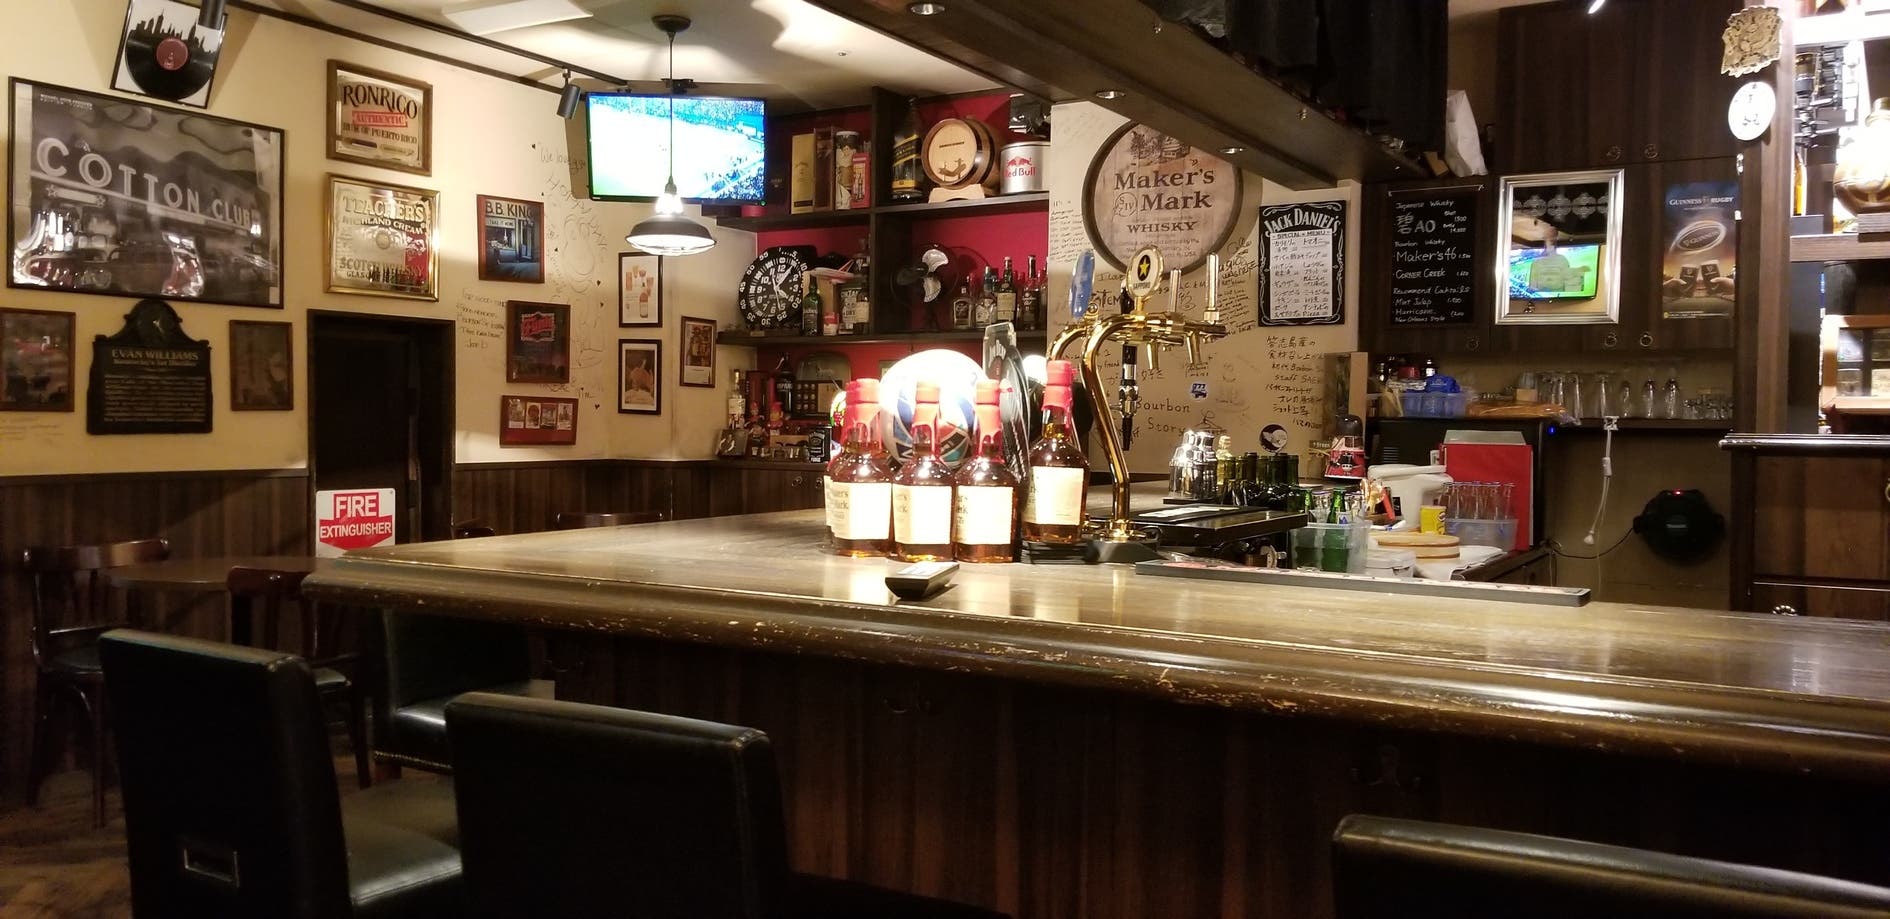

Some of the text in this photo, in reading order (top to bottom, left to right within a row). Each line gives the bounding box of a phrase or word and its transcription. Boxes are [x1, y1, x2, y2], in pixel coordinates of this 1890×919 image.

[343, 84, 418, 119] RONRICO
[1003, 166, 1036, 178] Red Bull
[1114, 168, 1216, 191] Maker's
[36, 137, 251, 227] COTTON CLUB
[1140, 190, 1213, 212] Mark
[1669, 196, 1734, 206] GUINNESS RUGBY
[1126, 220, 1199, 234] WHISKY
[1264, 208, 1341, 237] JACK DANIEL'S
[1414, 219, 1437, 233] AO
[1396, 249, 1444, 262] Maker's
[112, 349, 199, 361] EVAN WILLIAMS
[1136, 396, 1190, 413] Bourbon
[335, 494, 377, 519] FIRE
[320, 521, 392, 539] EXTINGUISHER
